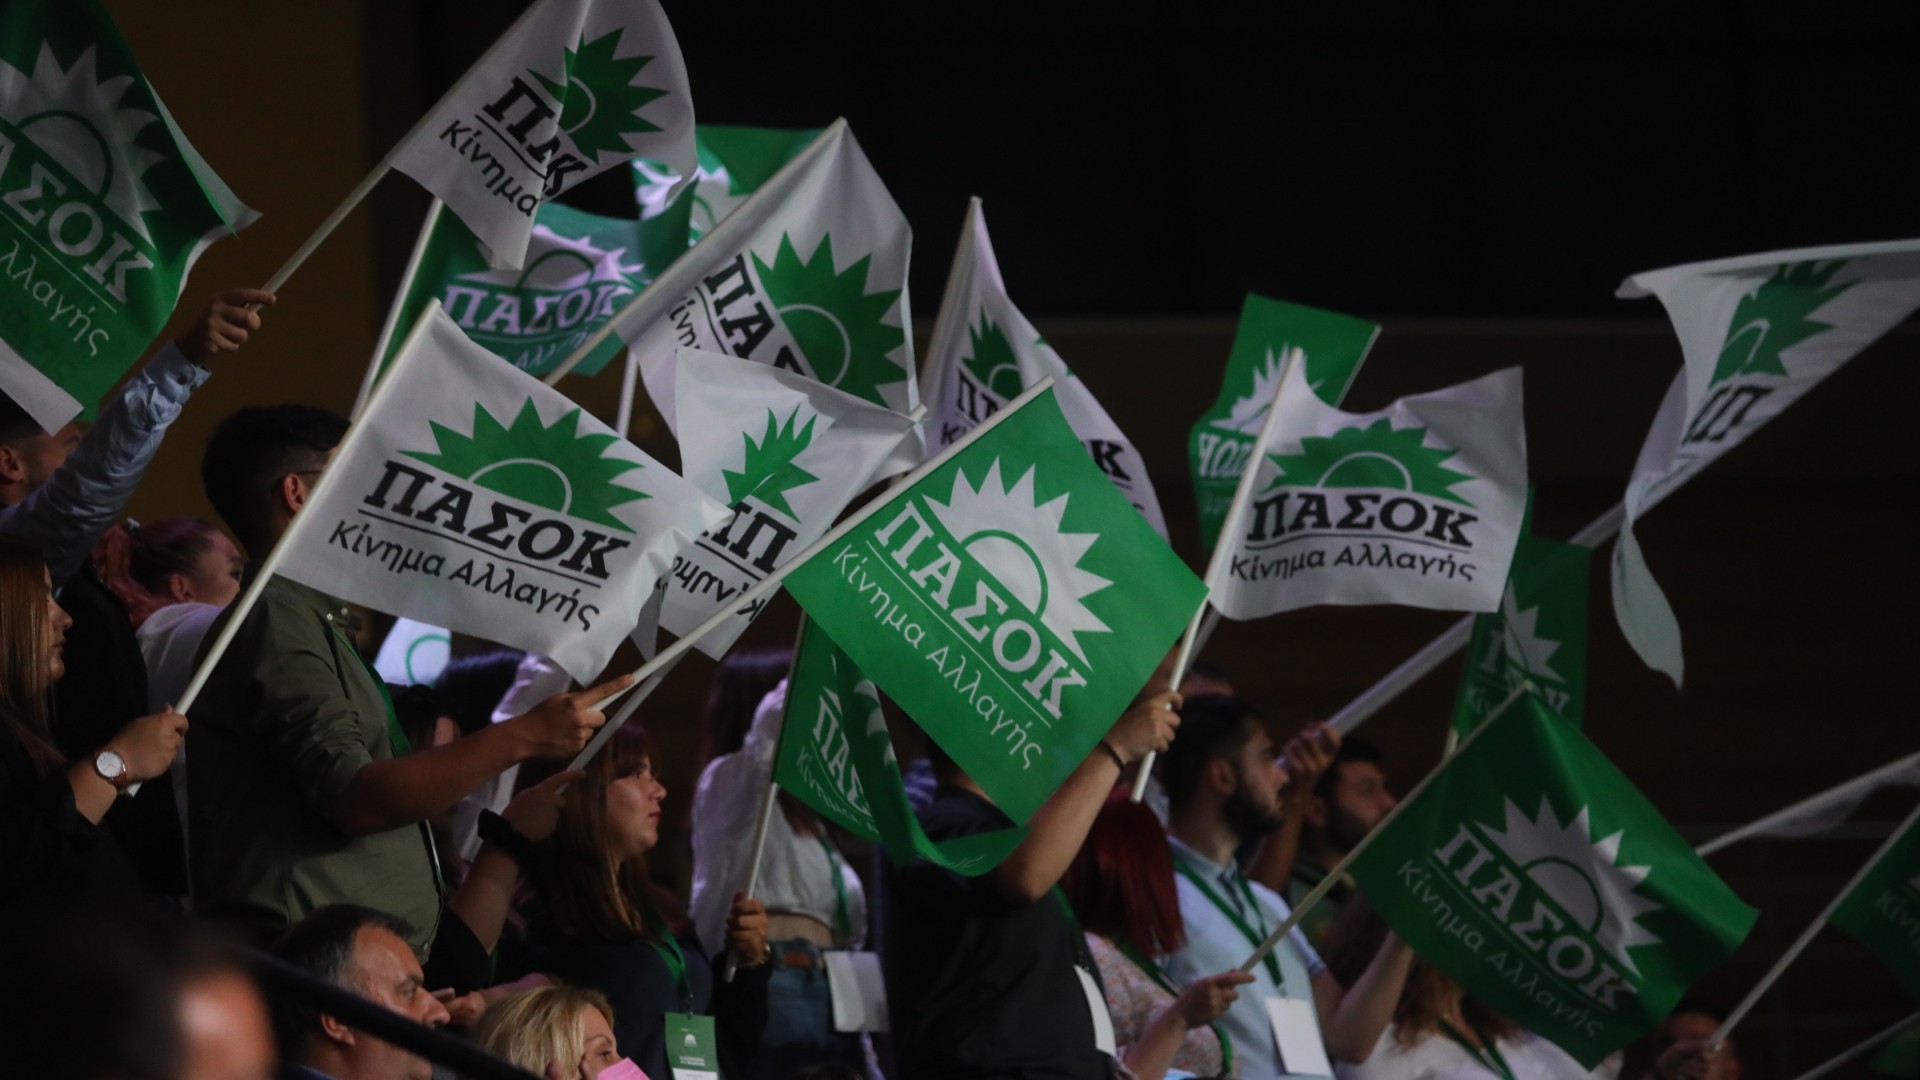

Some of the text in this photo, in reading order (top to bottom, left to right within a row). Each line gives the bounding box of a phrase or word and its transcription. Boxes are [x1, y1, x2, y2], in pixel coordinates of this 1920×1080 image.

[440, 120, 542, 217] Κίνημα
[442, 283, 635, 336] ΠΑΣΟΚ
[328, 520, 601, 632] Κίνημα Αλλαγής
[362, 459, 632, 580] ΠΑΣΟΚ
[1230, 542, 1477, 582] Κίνημα Αλλαγής
[1246, 493, 1479, 548] ΠΑΣΟΚ
[832, 544, 1042, 770] Κίνημα Αλλαγής
[873, 499, 1088, 720] ΠΑΣΟΚ
[1397, 858, 1604, 1038] Κίνημα Αλλαγής
[1433, 822, 1638, 1010] ΠΑΣΟΚ
